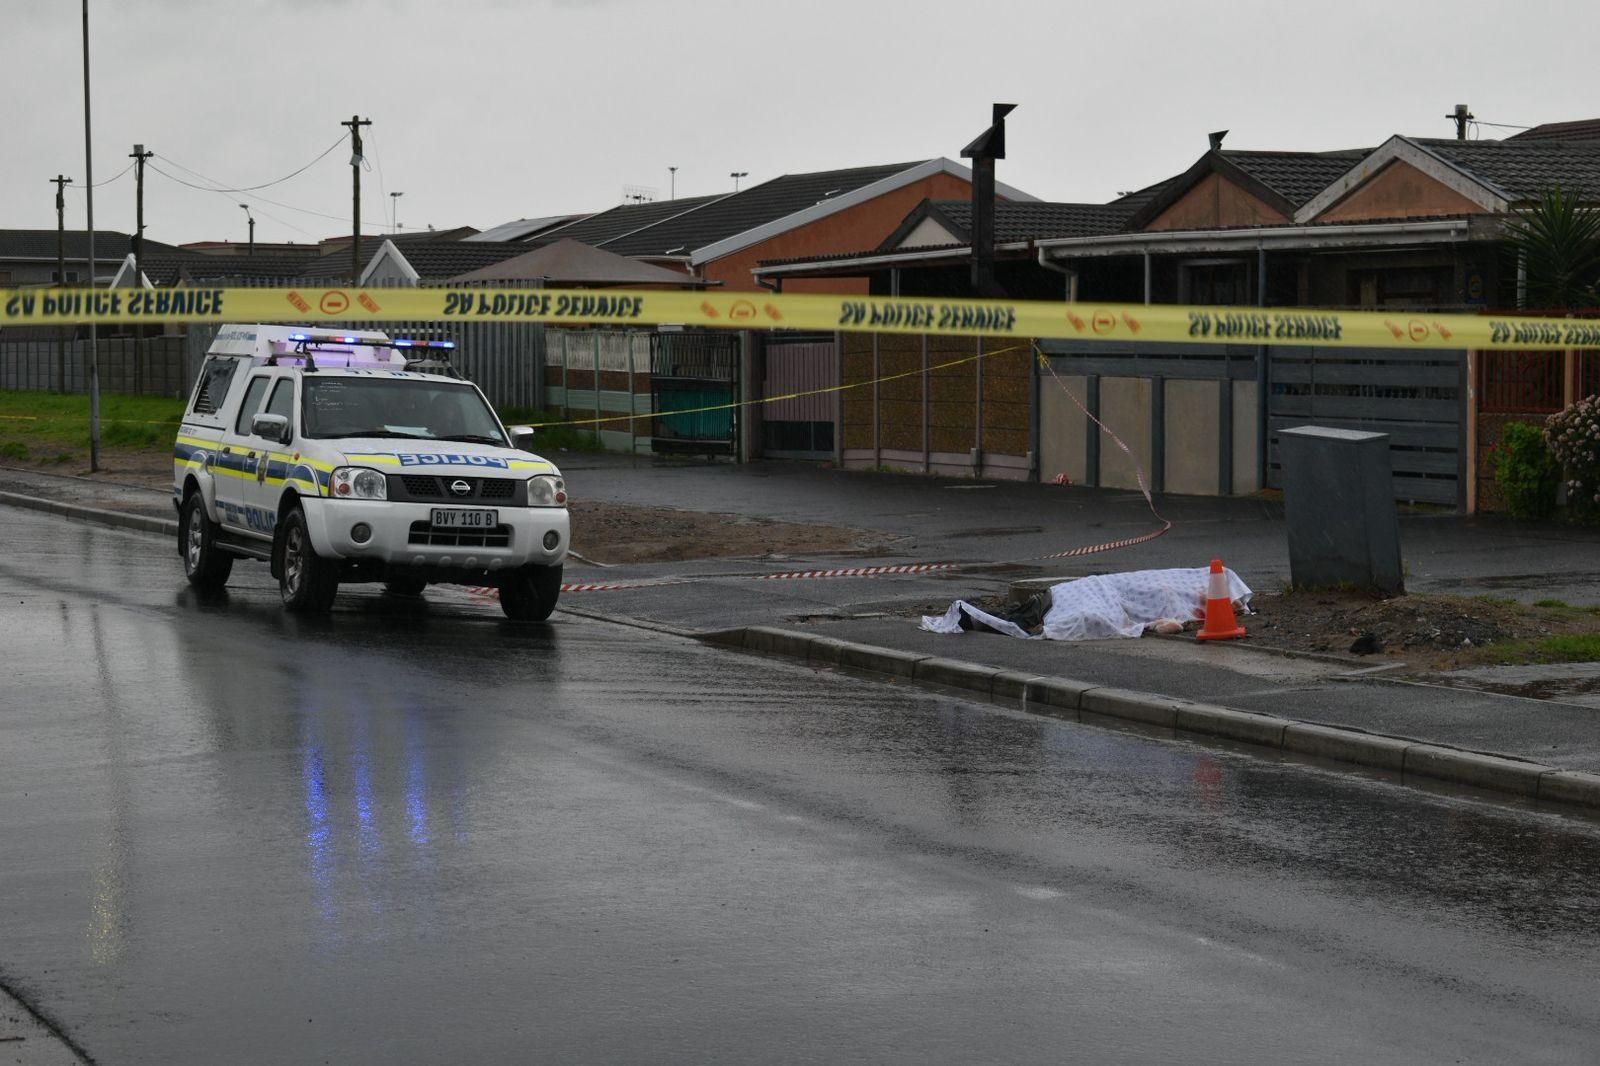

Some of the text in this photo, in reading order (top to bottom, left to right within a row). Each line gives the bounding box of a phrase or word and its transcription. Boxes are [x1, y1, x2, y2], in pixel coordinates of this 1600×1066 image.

[436, 512, 492, 526] BVY 110 B
